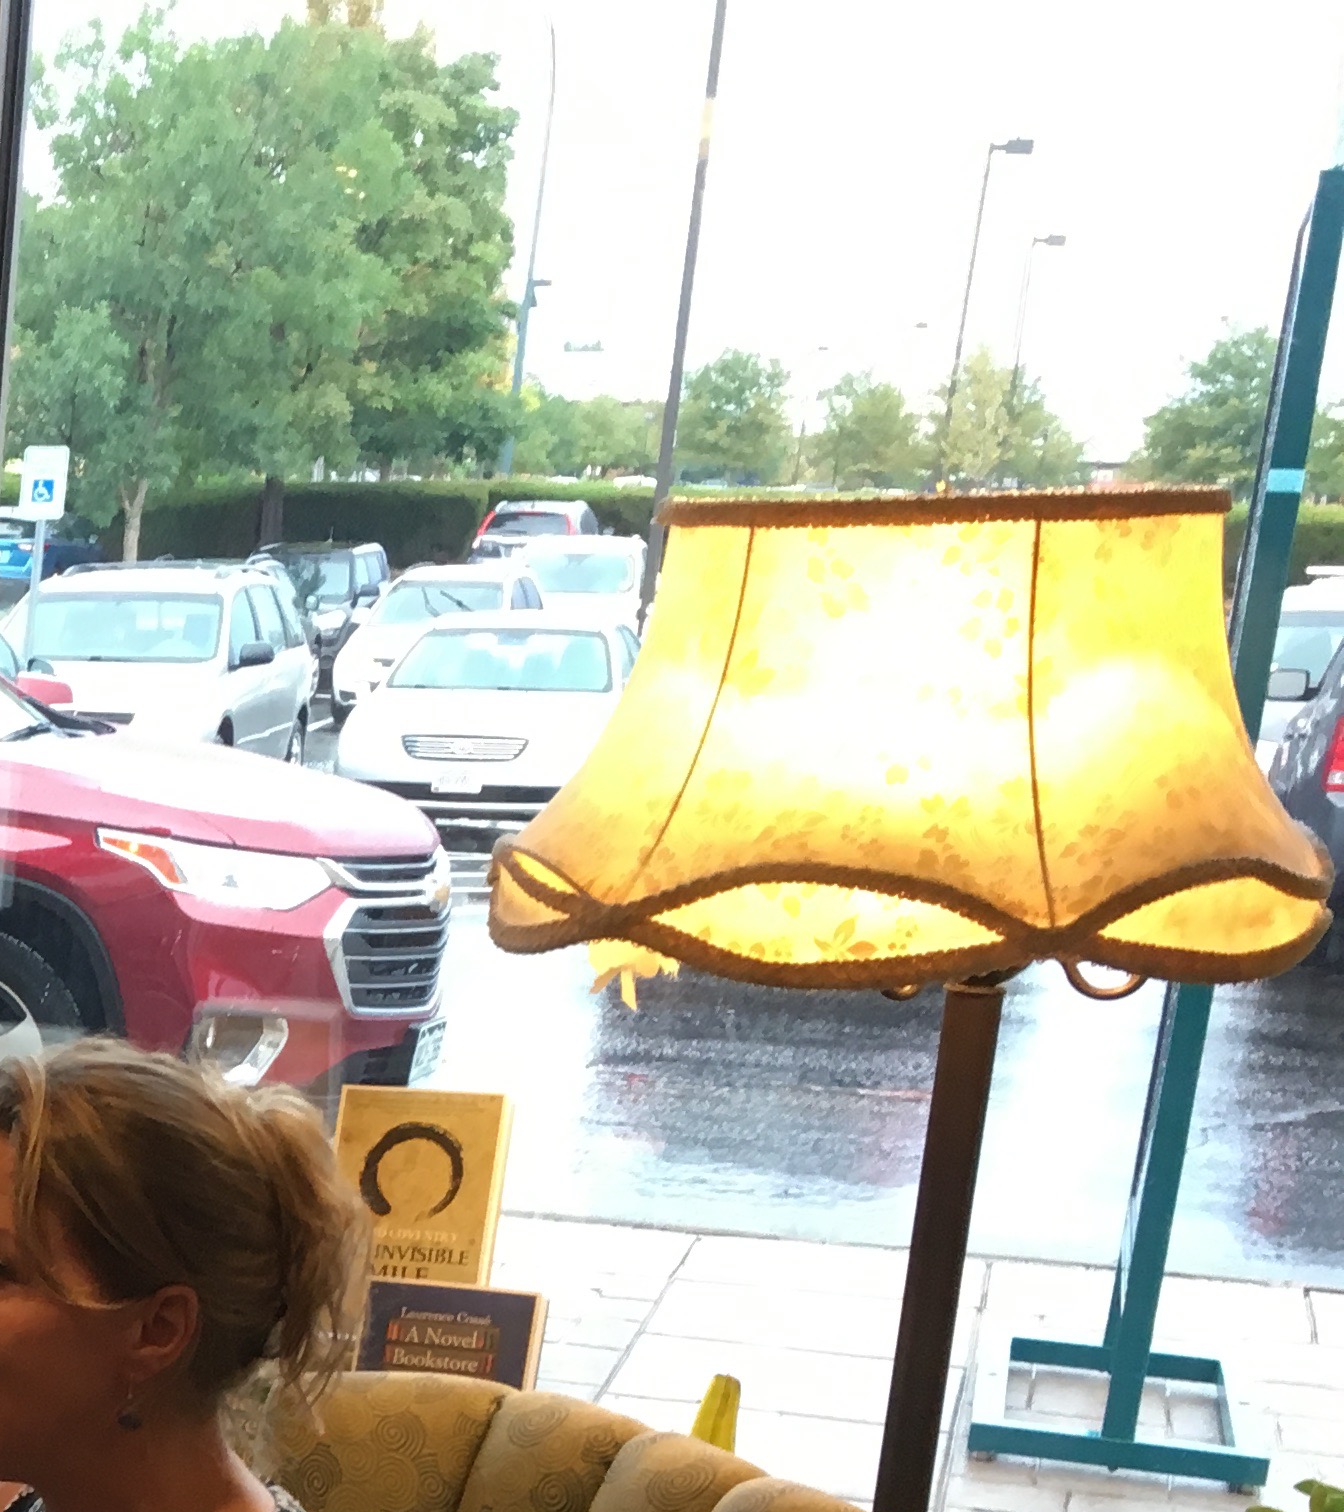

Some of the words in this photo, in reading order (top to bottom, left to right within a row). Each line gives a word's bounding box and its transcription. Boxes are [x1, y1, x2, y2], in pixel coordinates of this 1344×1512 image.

[375, 1243, 470, 1266] INVISIBLE
[404, 1326, 419, 1343] A
[424, 1327, 478, 1349] Novel
[393, 1347, 479, 1373] Bookstore
